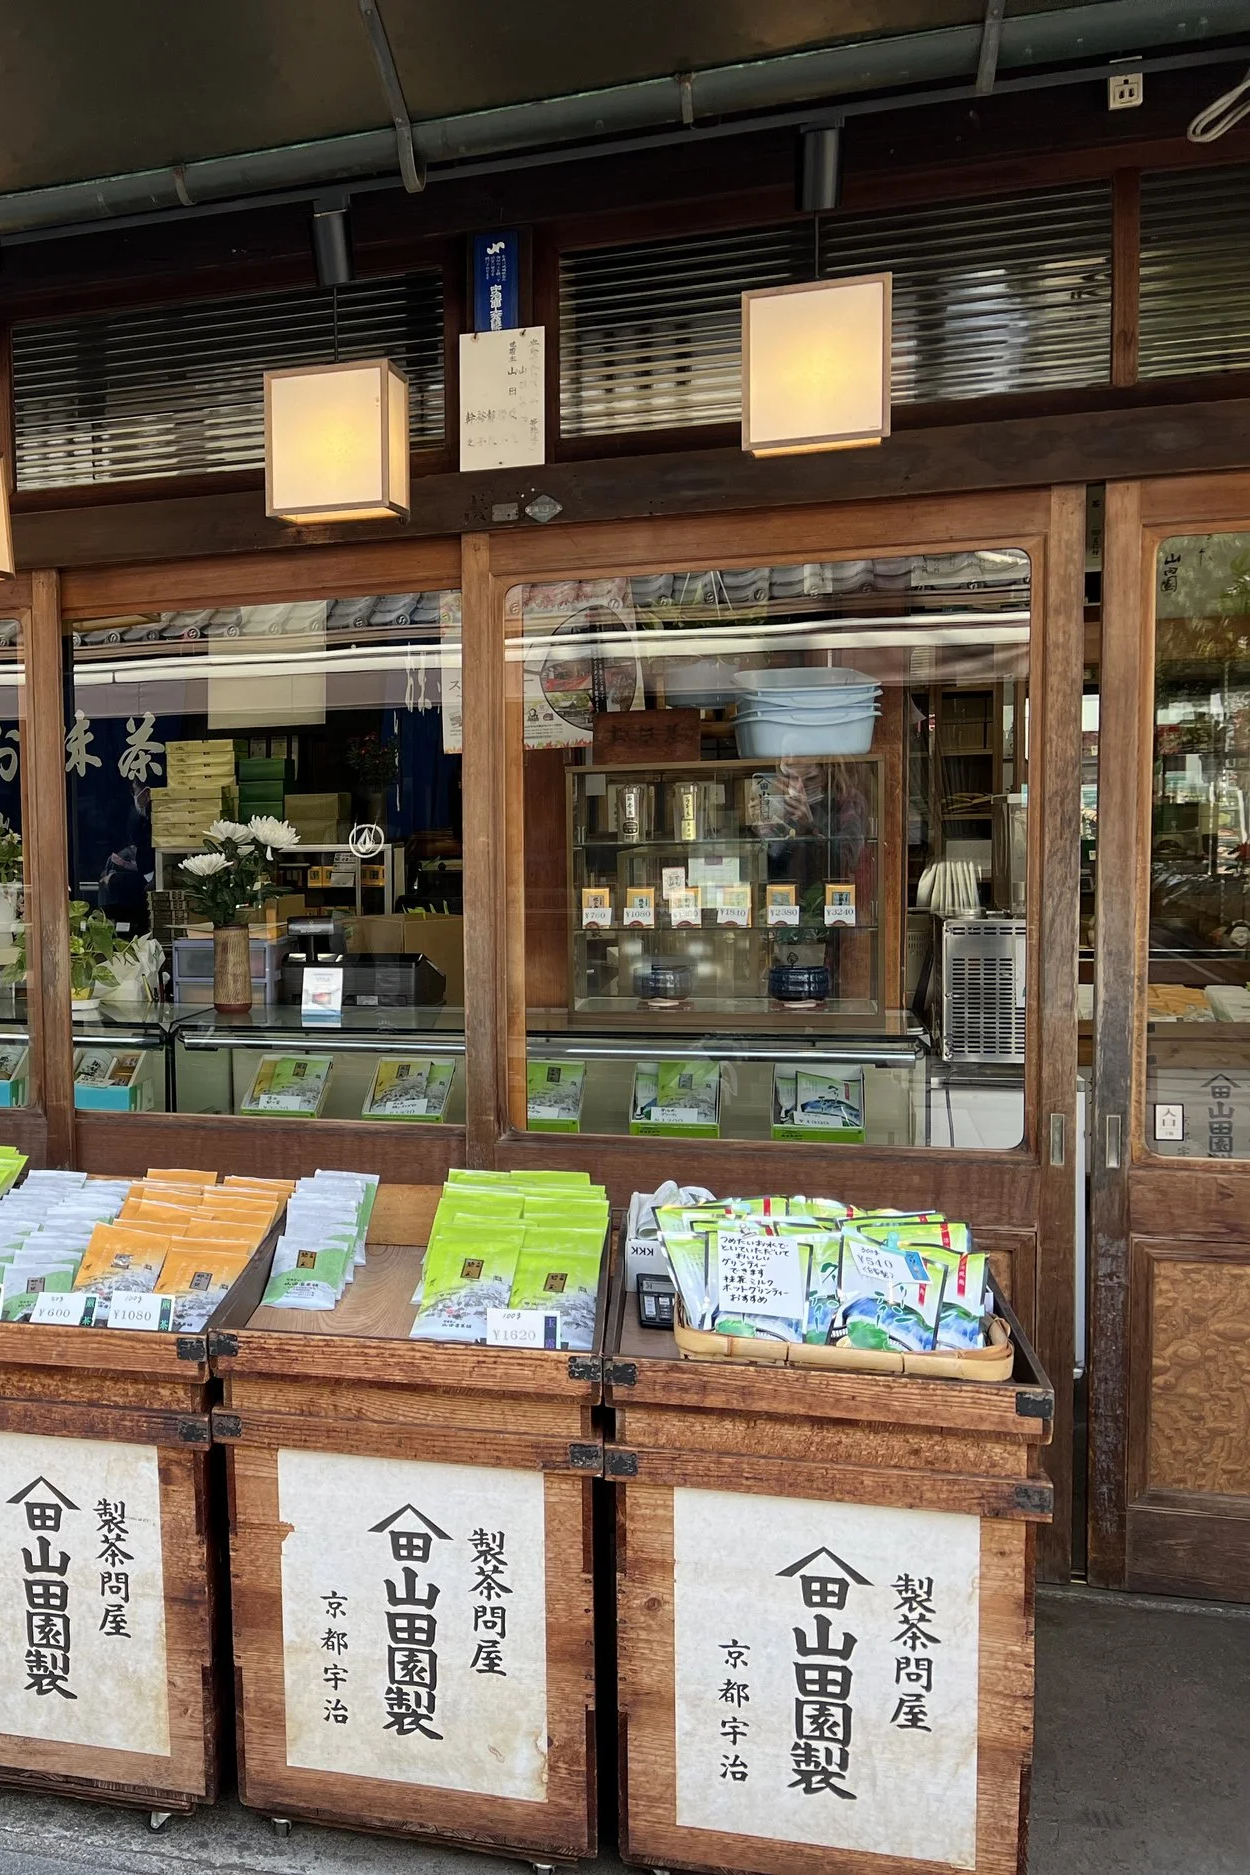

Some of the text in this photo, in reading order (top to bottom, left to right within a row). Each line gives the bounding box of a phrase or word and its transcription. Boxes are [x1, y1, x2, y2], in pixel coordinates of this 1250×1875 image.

[826, 908, 854, 916] ¥3240
[1162, 1108, 1177, 1127] 入口
[1208, 1101, 1235, 1157] 山田園
[735, 1253, 771, 1261] おいしい
[731, 1268, 764, 1278] できます
[730, 1294, 769, 1304] おすすめ
[38, 1308, 71, 1318] ¥600
[113, 1309, 152, 1321] ¥1080
[492, 1329, 537, 1341] ¥1620
[94, 1499, 134, 1638] 製茶問屋
[468, 1528, 512, 1676] 製茶問屋
[321, 1591, 348, 1724] 京都宇治
[891, 1574, 940, 1731] 製茶問屋
[719, 1639, 750, 1781] 京都宇治
